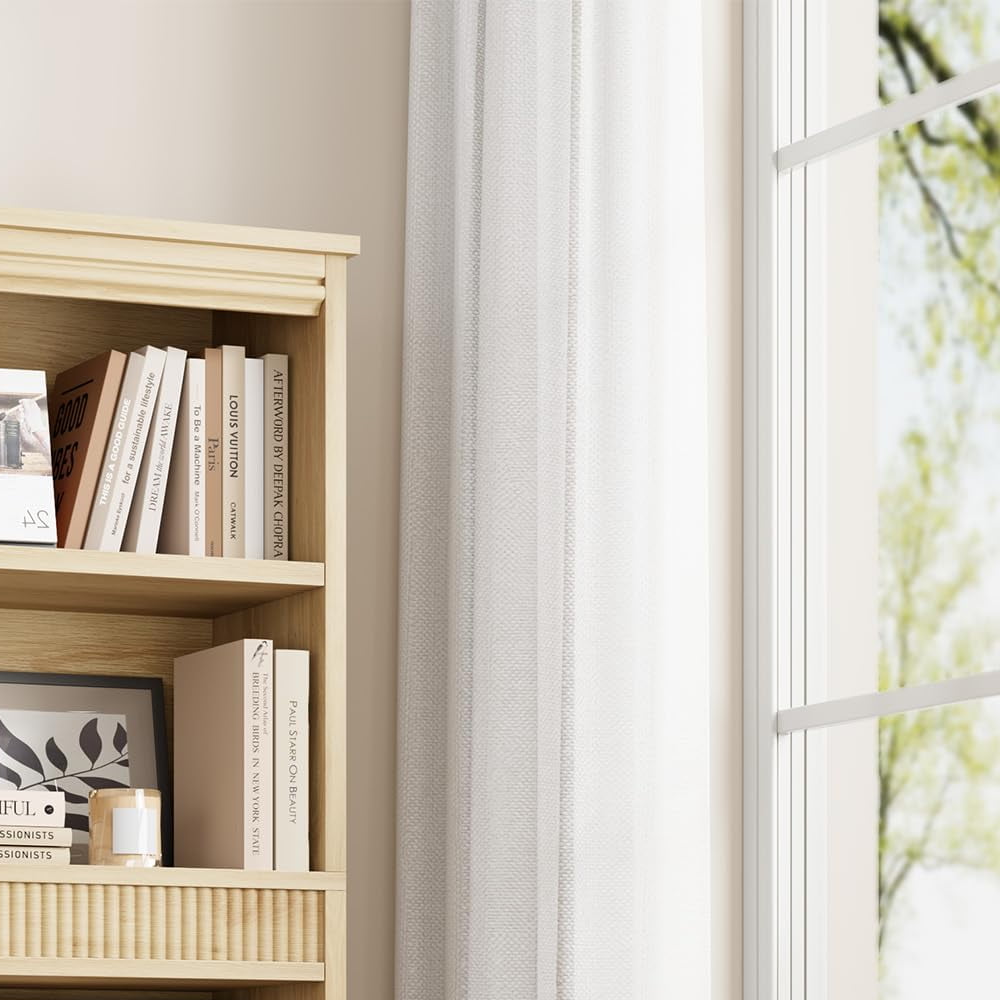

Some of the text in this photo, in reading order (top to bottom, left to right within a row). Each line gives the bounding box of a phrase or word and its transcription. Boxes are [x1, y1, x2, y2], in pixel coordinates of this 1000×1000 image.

[118, 398, 131, 430] GUIDE
[194, 405, 202, 416] To
[194, 420, 202, 432] Be
[122, 470, 131, 484] for
[129, 409, 146, 462] sustainable
[140, 372, 156, 408] lifestyle
[230, 395, 238, 478] LOUIS VUITTON
[110, 432, 123, 462] GOOD
[148, 473, 162, 511] DREAM
[161, 406, 172, 440] AWAKE
[208, 438, 219, 471] Paris
[108, 464, 116, 472] A
[274, 369, 283, 558] AFTERWORD BY DEEPAK CHOPRA
[100, 483, 110, 504] THIS
[252, 758, 260, 767] IN
